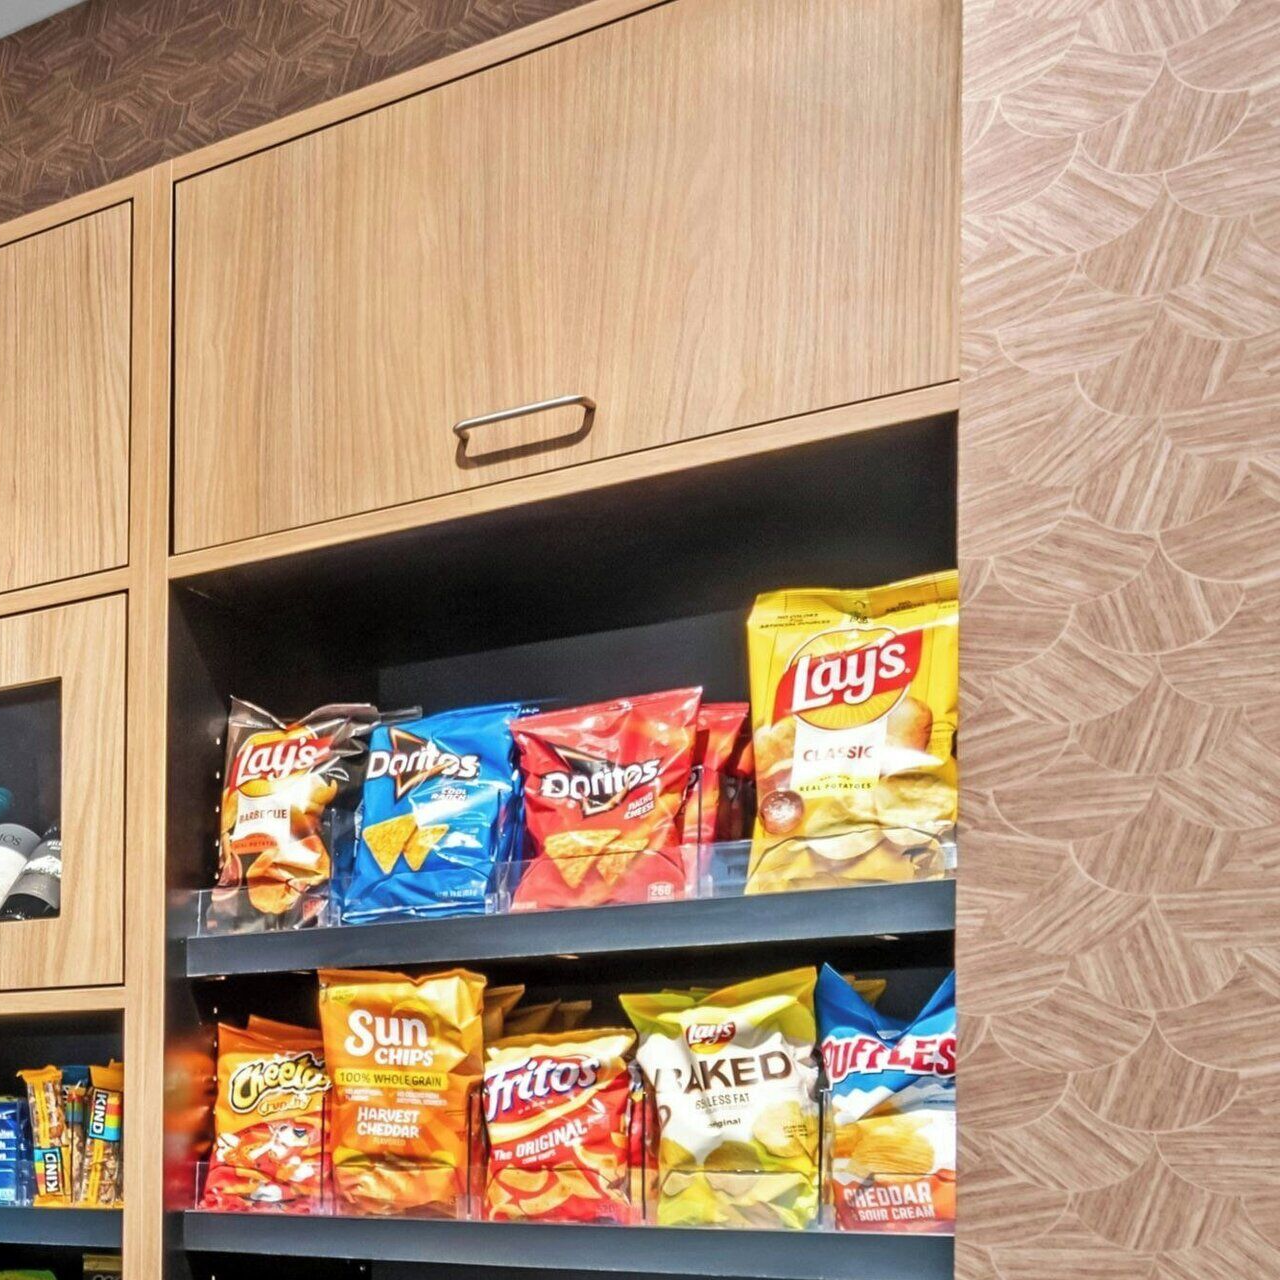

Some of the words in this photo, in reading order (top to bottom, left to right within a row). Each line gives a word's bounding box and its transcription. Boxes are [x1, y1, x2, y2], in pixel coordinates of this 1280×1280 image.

[792, 640, 906, 713] Lay's
[236, 738, 325, 785] Lay's
[366, 740, 481, 780] Doritos
[542, 758, 661, 799] Doritos
[825, 782, 872, 790] POTATOES
[344, 1009, 428, 1057] Sun
[689, 1021, 734, 1045] Lay's
[374, 1048, 434, 1067] CHIPS
[340, 1072, 371, 1084] 100%
[374, 1073, 410, 1085] WHOLE
[411, 1075, 442, 1087] GRAIN
[483, 1057, 600, 1122] Fritos
[93, 1092, 108, 1134] KIND
[356, 1106, 420, 1122] HARVEST
[734, 1092, 750, 1104] FAT
[356, 1120, 420, 1138] CHEDDAR
[493, 1148, 513, 1161] The
[515, 1118, 588, 1158] ORIGINAL
[46, 1153, 59, 1193] KIND
[843, 1181, 932, 1208] CHEDDAR
[859, 1208, 888, 1221] SOUR
[892, 1205, 936, 1220] CREAM
